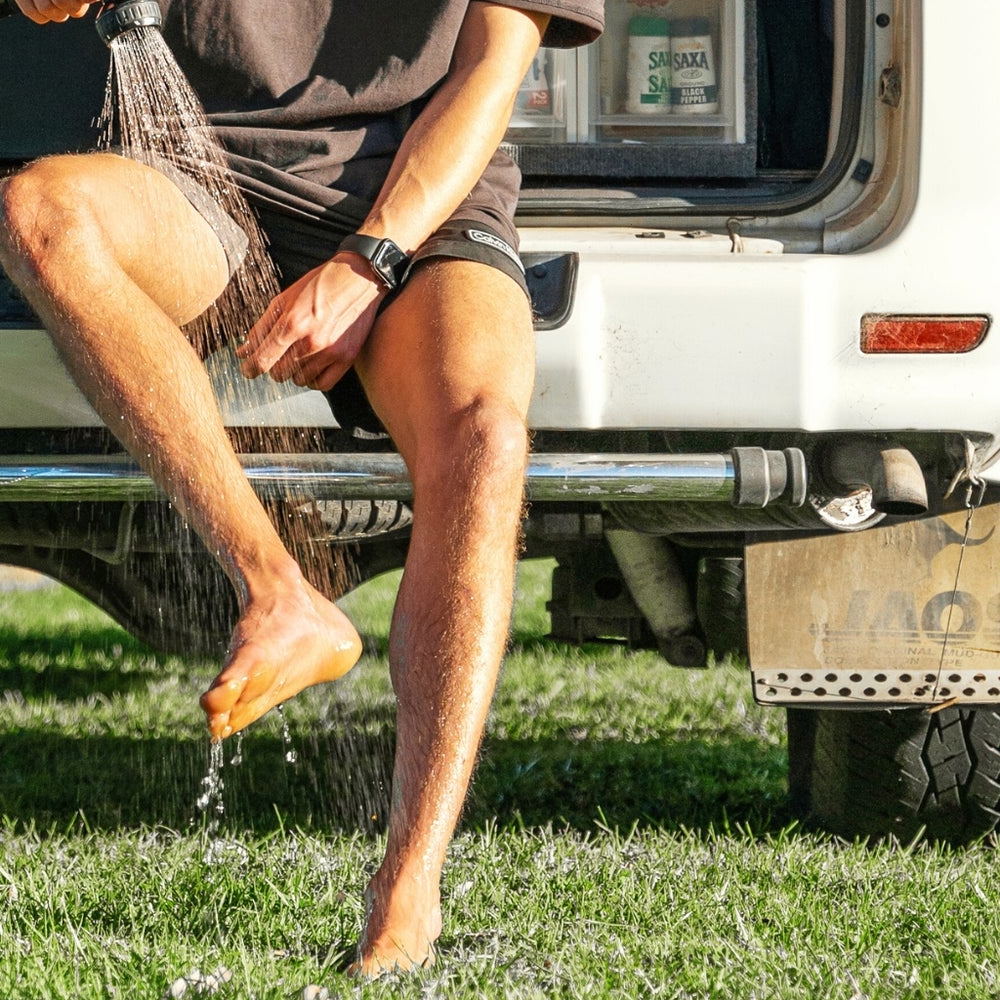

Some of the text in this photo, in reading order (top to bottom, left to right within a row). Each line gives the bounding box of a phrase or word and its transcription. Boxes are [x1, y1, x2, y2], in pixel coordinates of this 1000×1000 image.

[673, 51, 710, 71] SAXA
[681, 87, 705, 96] BLACK
[680, 95, 707, 104] PEPPER
